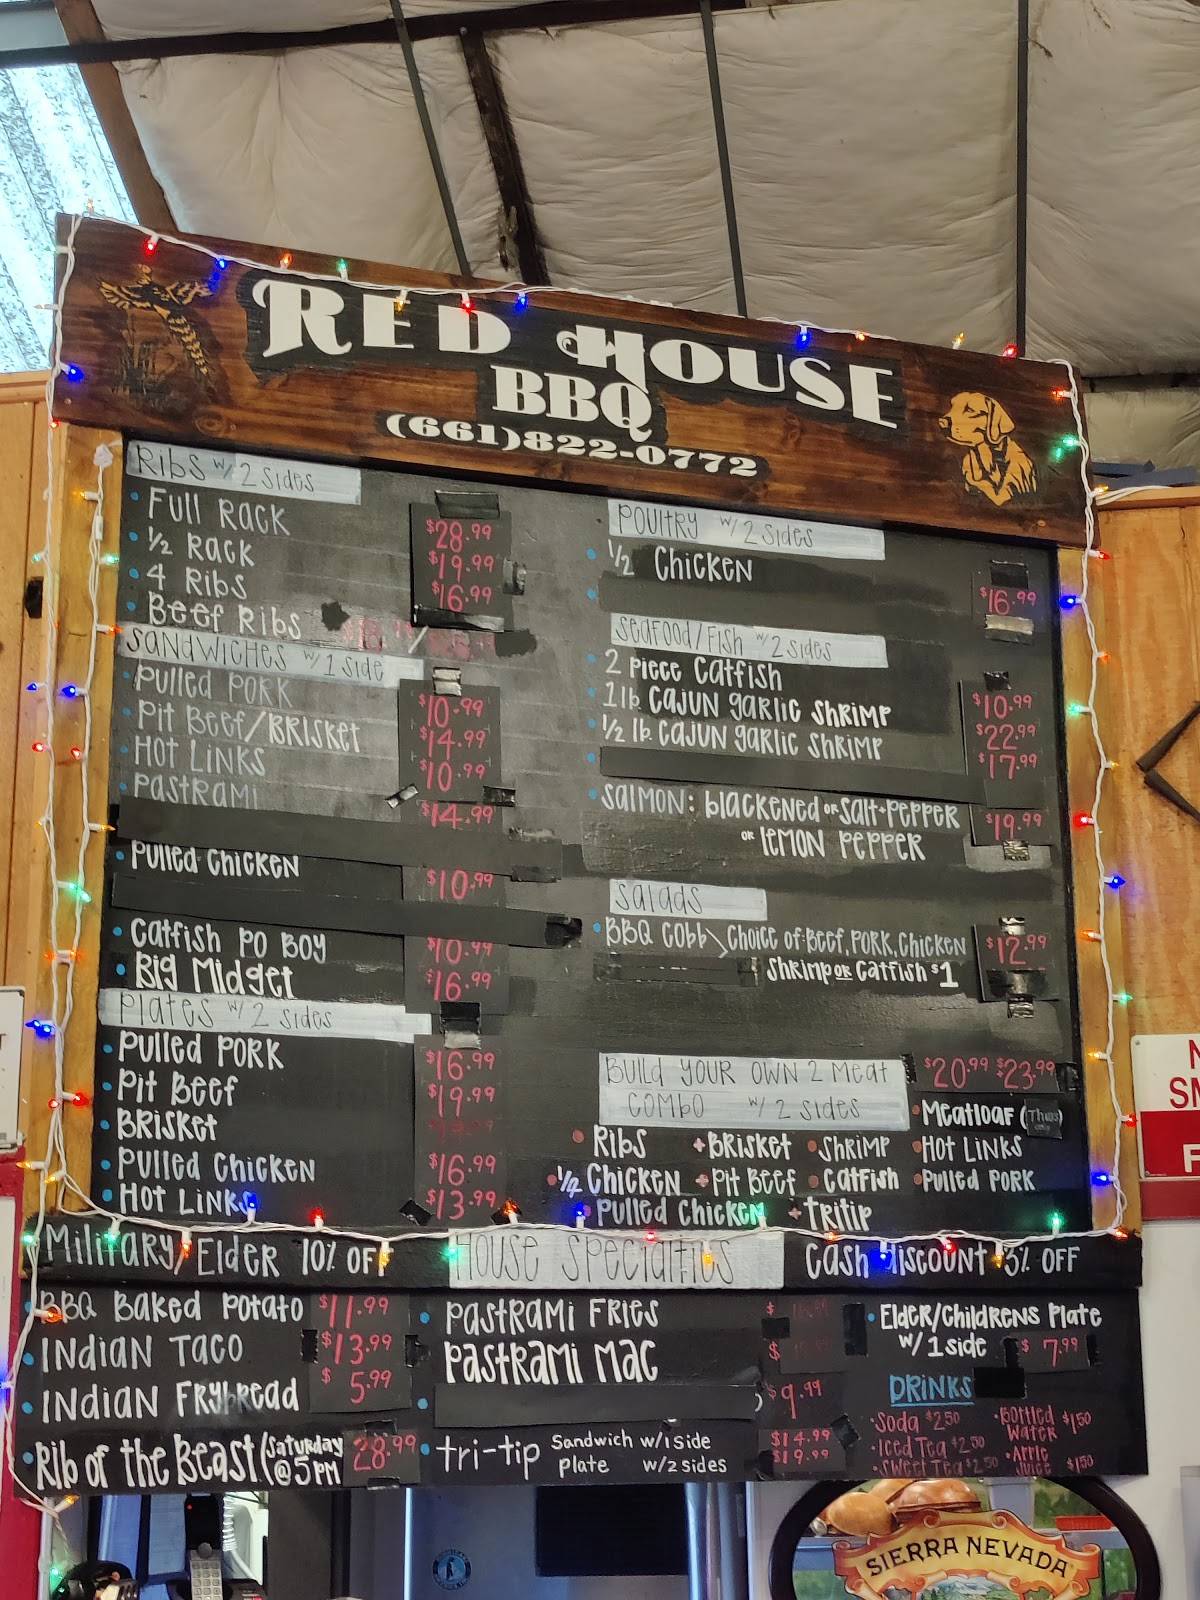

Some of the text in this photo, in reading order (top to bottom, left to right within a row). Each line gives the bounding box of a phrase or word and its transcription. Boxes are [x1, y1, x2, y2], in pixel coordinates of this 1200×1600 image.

[252, 278, 898, 430] RED HOUSE
[491, 365, 652, 443] BBQ
[386, 413, 759, 479] (661)822-0772
[241, 462, 257, 487] 2
[148, 527, 172, 555] 1/2
[426, 520, 492, 553] $28.99
[428, 551, 494, 583] $19.99
[607, 539, 634, 577] 1/2
[146, 563, 166, 592] 4
[432, 580, 492, 613] $16.99
[979, 586, 1037, 616] $16.99
[604, 649, 622, 677] 2
[229, 673, 293, 709] PORK
[972, 693, 1032, 719] $10.99
[418, 693, 484, 727] $10.99
[419, 726, 486, 760] $14.99
[975, 722, 1036, 752] $22.99
[419, 761, 486, 792] $10.99
[977, 752, 1038, 780] $17.99
[420, 803, 493, 828] $14.99
[985, 812, 1042, 840] $19.99
[427, 869, 493, 900] $10.99
[238, 927, 268, 959] PO
[606, 916, 653, 947] BBQ
[985, 933, 1047, 967] $12.99
[135, 951, 295, 999] Big Midget
[426, 968, 492, 1003] $16.99
[218, 1035, 285, 1070] PORK
[426, 1050, 495, 1080] $16.99
[680, 1058, 735, 1086] YOUR
[752, 1061, 798, 1086] OWN
[809, 1060, 825, 1083] 2
[924, 1057, 989, 1088] $20.99
[428, 1084, 495, 1118] $19.99
[775, 1096, 790, 1119] 2
[428, 1152, 497, 1186] $16.99
[989, 1169, 1035, 1193] PORK
[427, 1189, 497, 1220] $13.99
[301, 1238, 336, 1276] 10%
[1041, 1246, 1080, 1274] OFF
[319, 1294, 389, 1328] $11.99
[321, 1331, 392, 1366] $13.99
[771, 1429, 830, 1447] $14.99
[35, 1440, 78, 1491] Rib
[120, 1437, 169, 1486] the
[436, 1431, 633, 1480] tri-tip Sandwich
[559, 1458, 610, 1479] plate
[773, 1449, 829, 1465] $19.99
[866, 1535, 1070, 1578] SIERRA NEVADA
